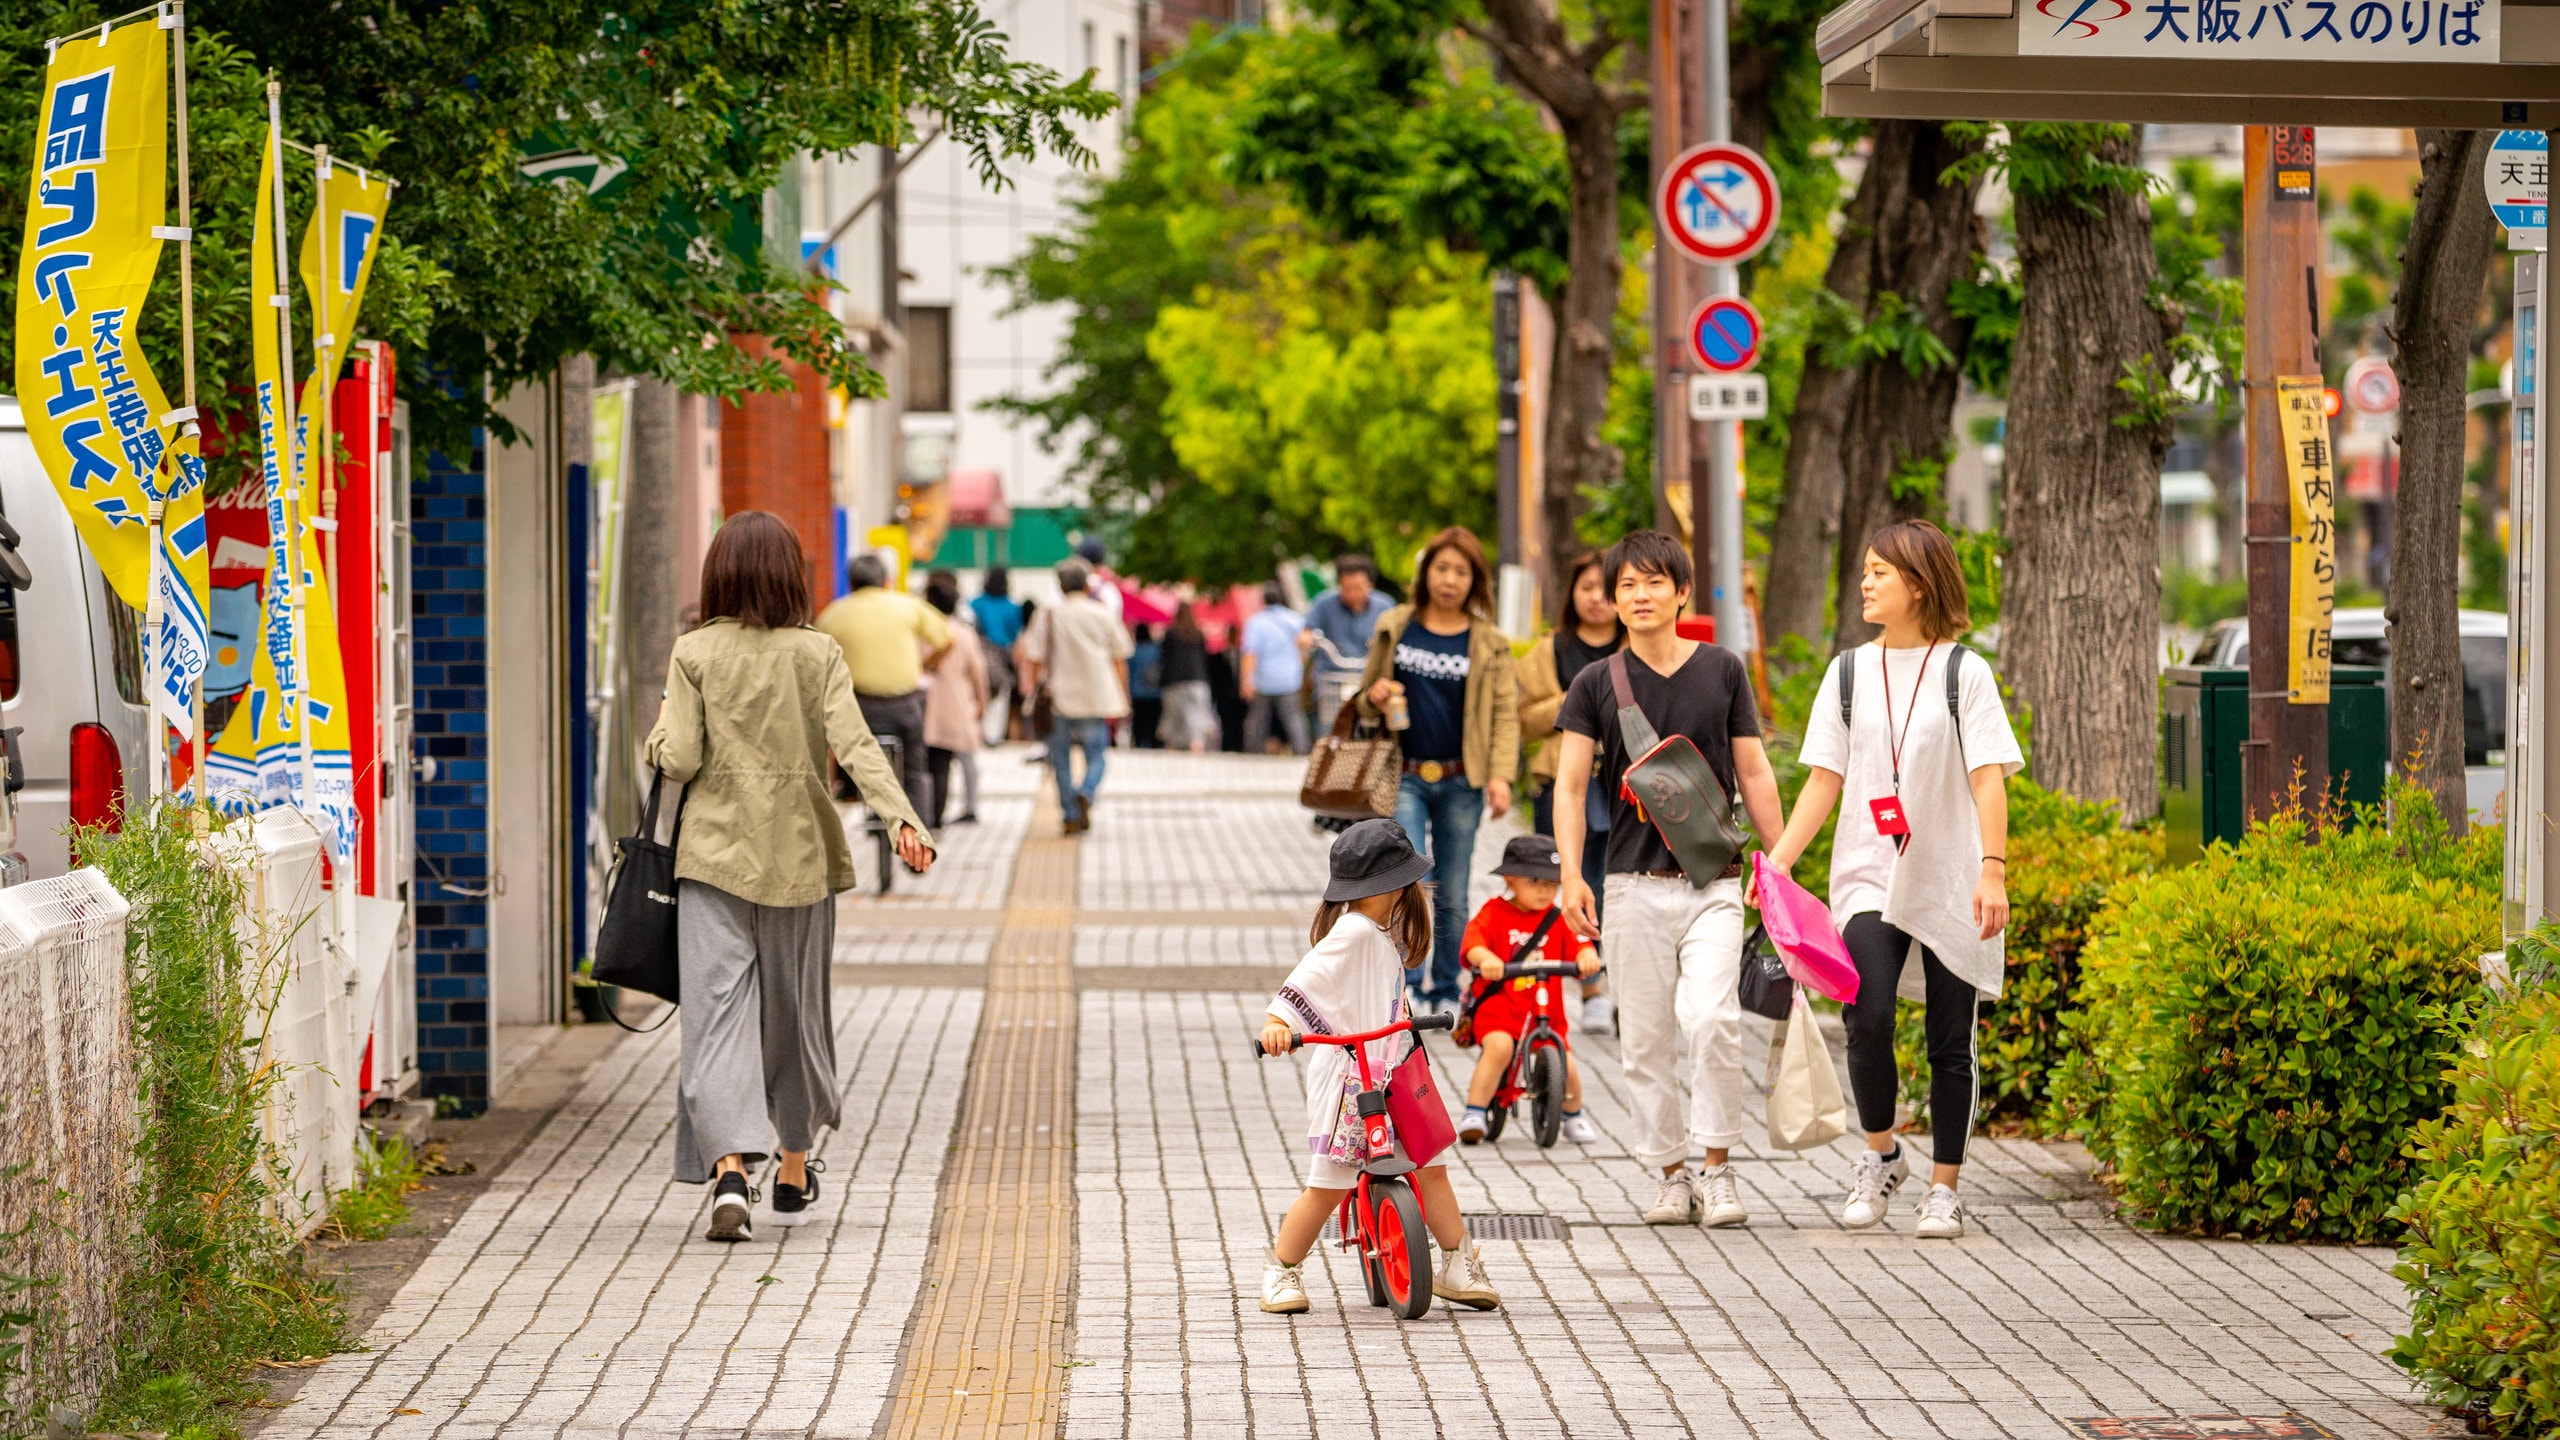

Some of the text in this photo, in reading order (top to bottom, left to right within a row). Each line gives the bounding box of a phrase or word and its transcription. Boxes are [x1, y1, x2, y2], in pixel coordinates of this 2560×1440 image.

[2144, 0, 2482, 46] 大阪バスのりば
